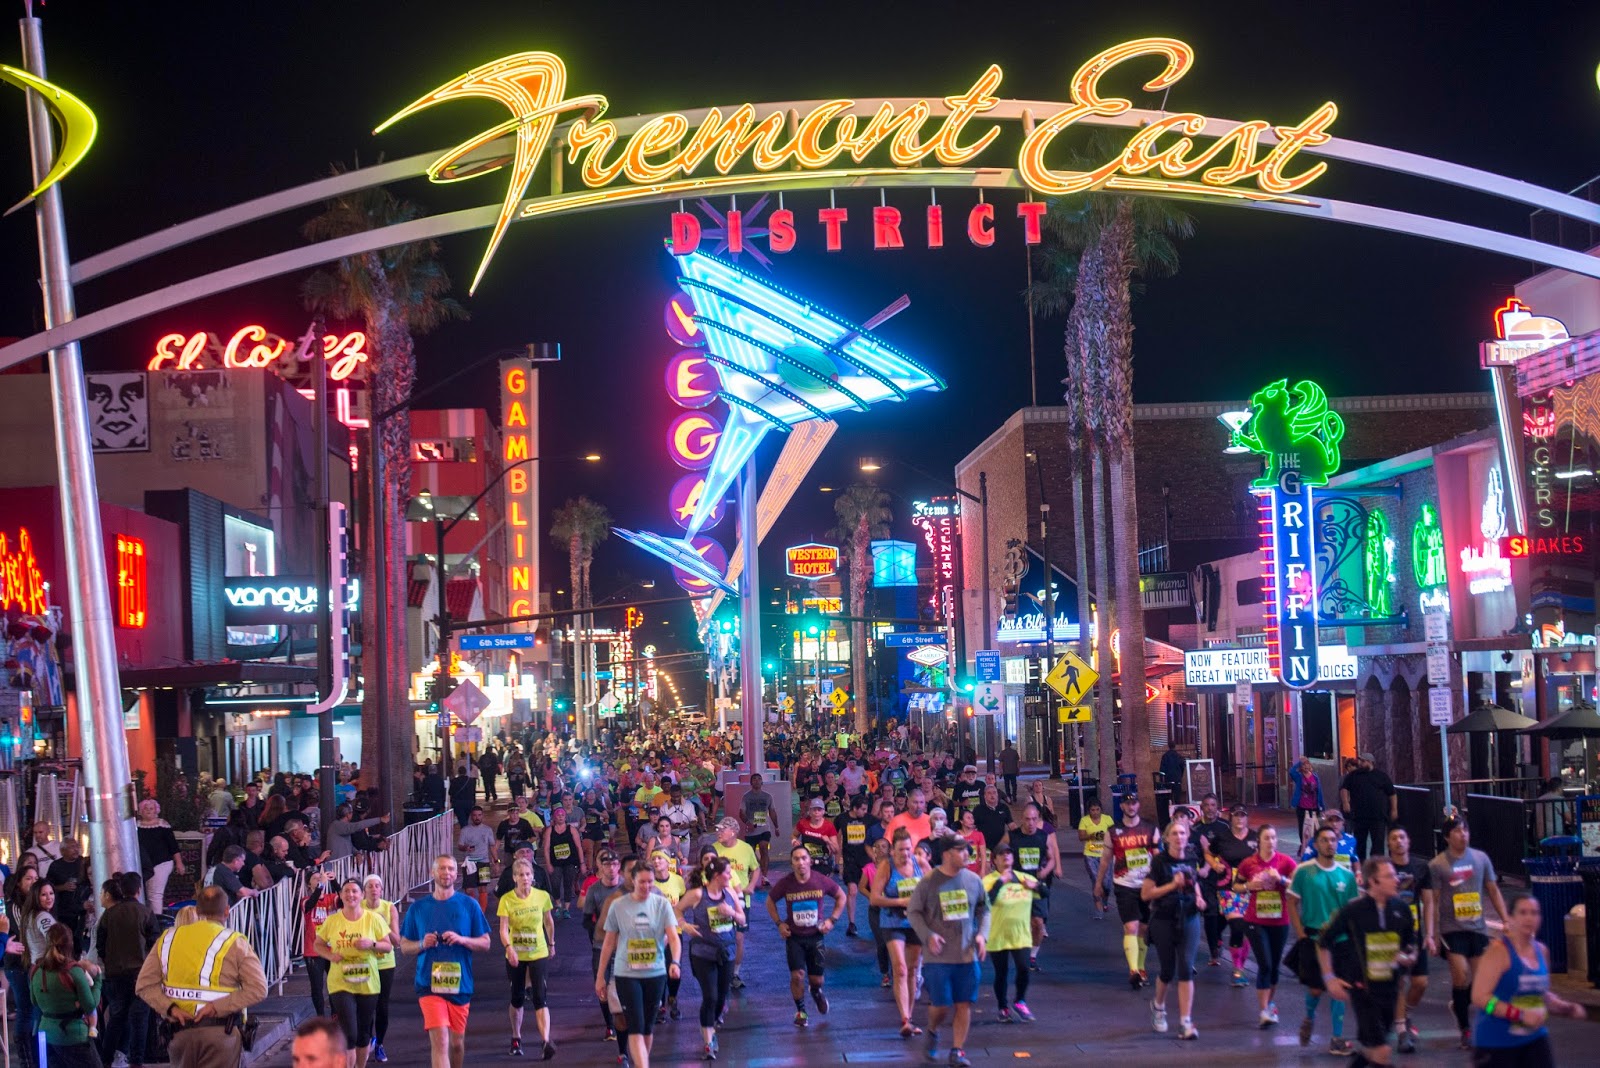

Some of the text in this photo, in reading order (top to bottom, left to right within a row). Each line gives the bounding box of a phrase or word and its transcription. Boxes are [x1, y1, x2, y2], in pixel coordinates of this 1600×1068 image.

[373, 37, 1338, 296] Fremont East
[671, 201, 1047, 256] DISTRICT
[223, 324, 369, 381] Cotez
[1277, 452, 1301, 469] THE
[506, 369, 532, 624] GAMBLING
[912, 501, 960, 518] Fremot
[940, 518, 953, 578] COUNTRY
[1510, 536, 1584, 556] SHAKES
[788, 549, 837, 561] WESTERN
[794, 563, 833, 575] HOTEL
[1280, 470, 1310, 682] GRIFFIN
[225, 578, 359, 613] vangud
[999, 614, 1015, 630] Bar
[1023, 612, 1069, 630] Billirds
[479, 638, 493, 647] 6th
[494, 638, 518, 647] Street
[902, 636, 913, 644] 6th
[914, 636, 934, 644] Street
[1190, 654, 1212, 668] NOW
[1189, 669, 1220, 683] GREAT
[1225, 668, 1270, 682] WHISKEY
[796, 913, 816, 921] 9806
[631, 952, 655, 961] 18327
[162, 988, 202, 999] POLICE
